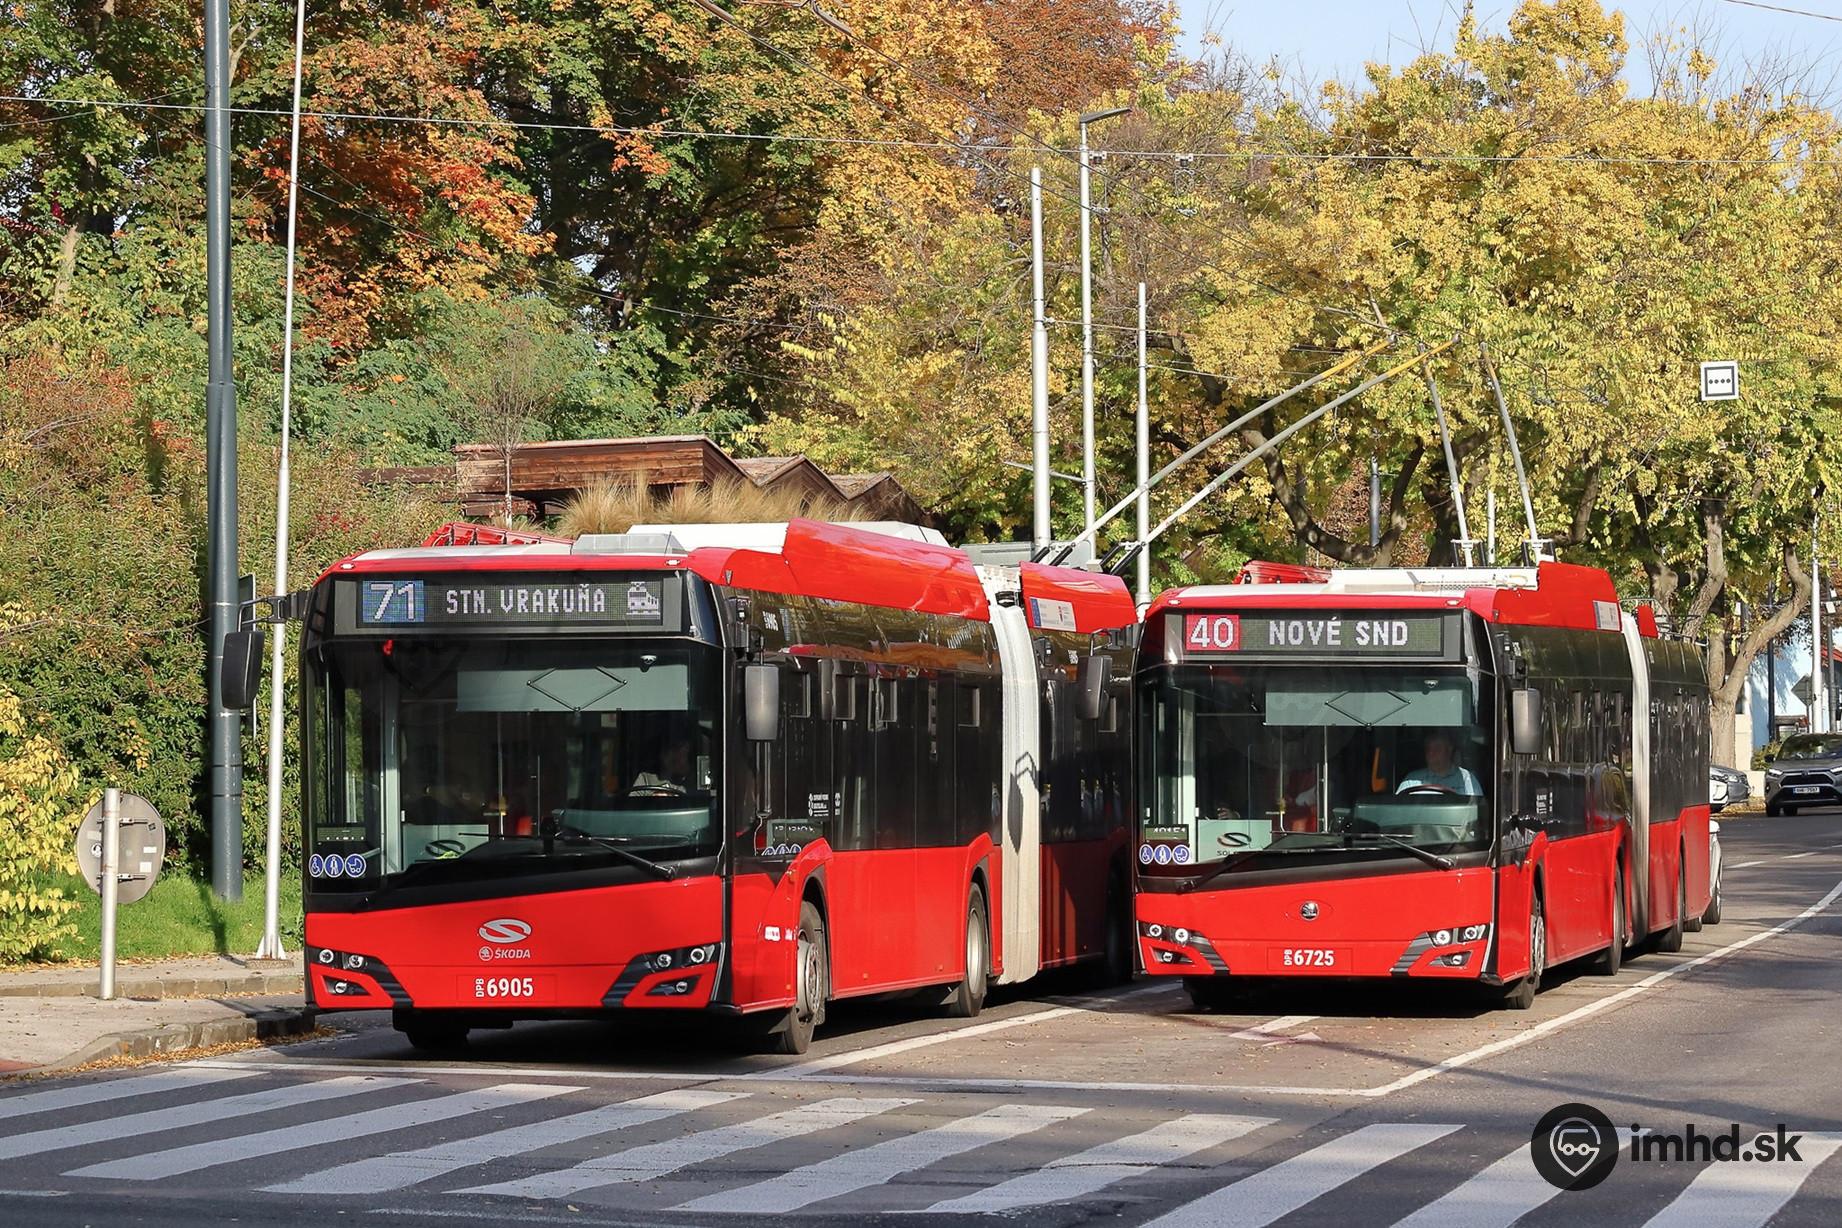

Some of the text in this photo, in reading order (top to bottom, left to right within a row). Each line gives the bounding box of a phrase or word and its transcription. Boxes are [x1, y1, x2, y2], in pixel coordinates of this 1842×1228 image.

[370, 582, 416, 621] 71
[446, 584, 606, 614] STN. VRAKUŇA
[1190, 617, 1234, 648] 40
[1269, 616, 1408, 646] NOVÉ SND
[494, 947, 531, 959] ŠKODA
[1294, 949, 1335, 967] 6725
[475, 977, 534, 998] DPB 6905
